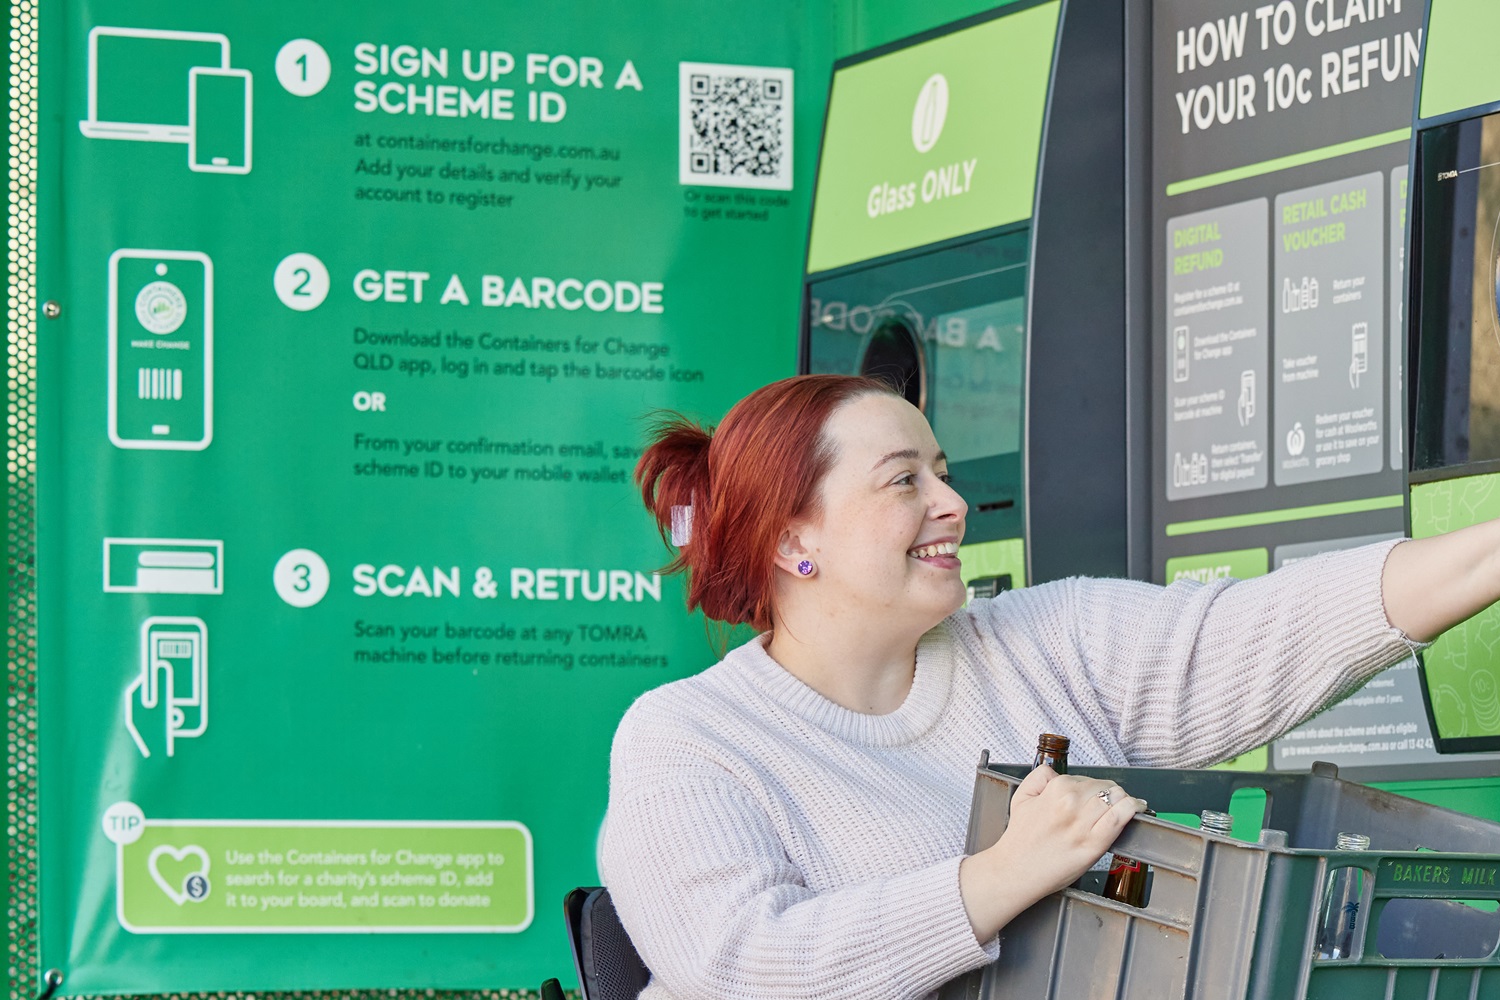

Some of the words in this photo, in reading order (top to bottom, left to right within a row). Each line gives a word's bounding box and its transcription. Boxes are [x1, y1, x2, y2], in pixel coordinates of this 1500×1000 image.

[1177, 12, 1248, 74] HOW
[1256, 0, 1297, 51] TO
[294, 53, 309, 83] 1
[353, 43, 448, 77] SIGN
[461, 50, 515, 81] UP
[525, 53, 604, 87] FOR
[614, 60, 643, 90] A
[1175, 74, 1257, 135] YOUR
[1263, 63, 1313, 113] 10c
[1321, 28, 1423, 99] REFUN
[353, 81, 515, 119] SCHEME
[527, 90, 567, 122] ID
[353, 132, 372, 147] at
[375, 136, 621, 160] containersforchange.com.au
[354, 158, 392, 175] Add
[395, 164, 434, 180] your
[438, 162, 494, 181] details
[497, 167, 531, 183] and
[533, 169, 581, 189] verify
[584, 174, 622, 189] your
[354, 187, 422, 202] account
[425, 189, 445, 204] to
[448, 191, 514, 209] register
[867, 181, 916, 219] Glass
[920, 158, 978, 204] ONLY
[1283, 199, 1328, 226] RETAIL
[1330, 188, 1367, 215] CASH
[1173, 222, 1222, 249] DIGITAL
[1283, 222, 1346, 253] VOUCHER
[1173, 249, 1224, 276] REFUND
[292, 268, 312, 296] 2
[352, 269, 431, 302] GET
[438, 274, 470, 304] A
[480, 276, 664, 312] BARCODE
[353, 327, 441, 347] Download
[444, 330, 474, 349] the
[477, 332, 571, 352] Containers
[574, 335, 599, 353] for
[602, 337, 670, 360] Change
[352, 353, 394, 370] QLD
[397, 358, 437, 377] app,
[440, 356, 470, 378] log
[472, 357, 489, 374] in
[492, 359, 526, 376] and
[528, 362, 559, 382] tap
[561, 361, 592, 378] the
[594, 362, 666, 380] barcode
[668, 364, 704, 382] icon
[352, 391, 387, 412] OR
[353, 432, 400, 450] From
[402, 439, 442, 456] your
[445, 437, 554, 455] confirmation
[557, 441, 608, 459] email,
[612, 446, 643, 459] sav
[353, 459, 420, 477] scheme
[423, 460, 444, 478] ID
[447, 464, 467, 478] to
[470, 466, 509, 483] your
[513, 464, 572, 481] mobile
[576, 466, 626, 483] wallet
[292, 563, 311, 593] 3
[351, 564, 461, 596] SCAN
[471, 566, 499, 598] &
[508, 568, 665, 600] RETURN
[353, 620, 395, 637] Scan
[399, 625, 439, 642] your
[443, 622, 516, 640] barcode
[519, 626, 537, 640] at
[542, 628, 574, 644] any
[576, 624, 647, 642] TOMRA
[352, 647, 428, 663] machine
[431, 647, 491, 664] before
[494, 650, 575, 670] returning
[577, 652, 669, 667] containers
[108, 815, 141, 831] TIP
[225, 850, 254, 864] Use
[257, 849, 283, 864] the
[286, 849, 367, 864] Containers
[369, 850, 391, 864] for
[394, 850, 452, 868] Change
[456, 853, 484, 868] app
[487, 852, 504, 865] to
[1393, 863, 1451, 884] BAKERS
[1461, 866, 1497, 887] MILK
